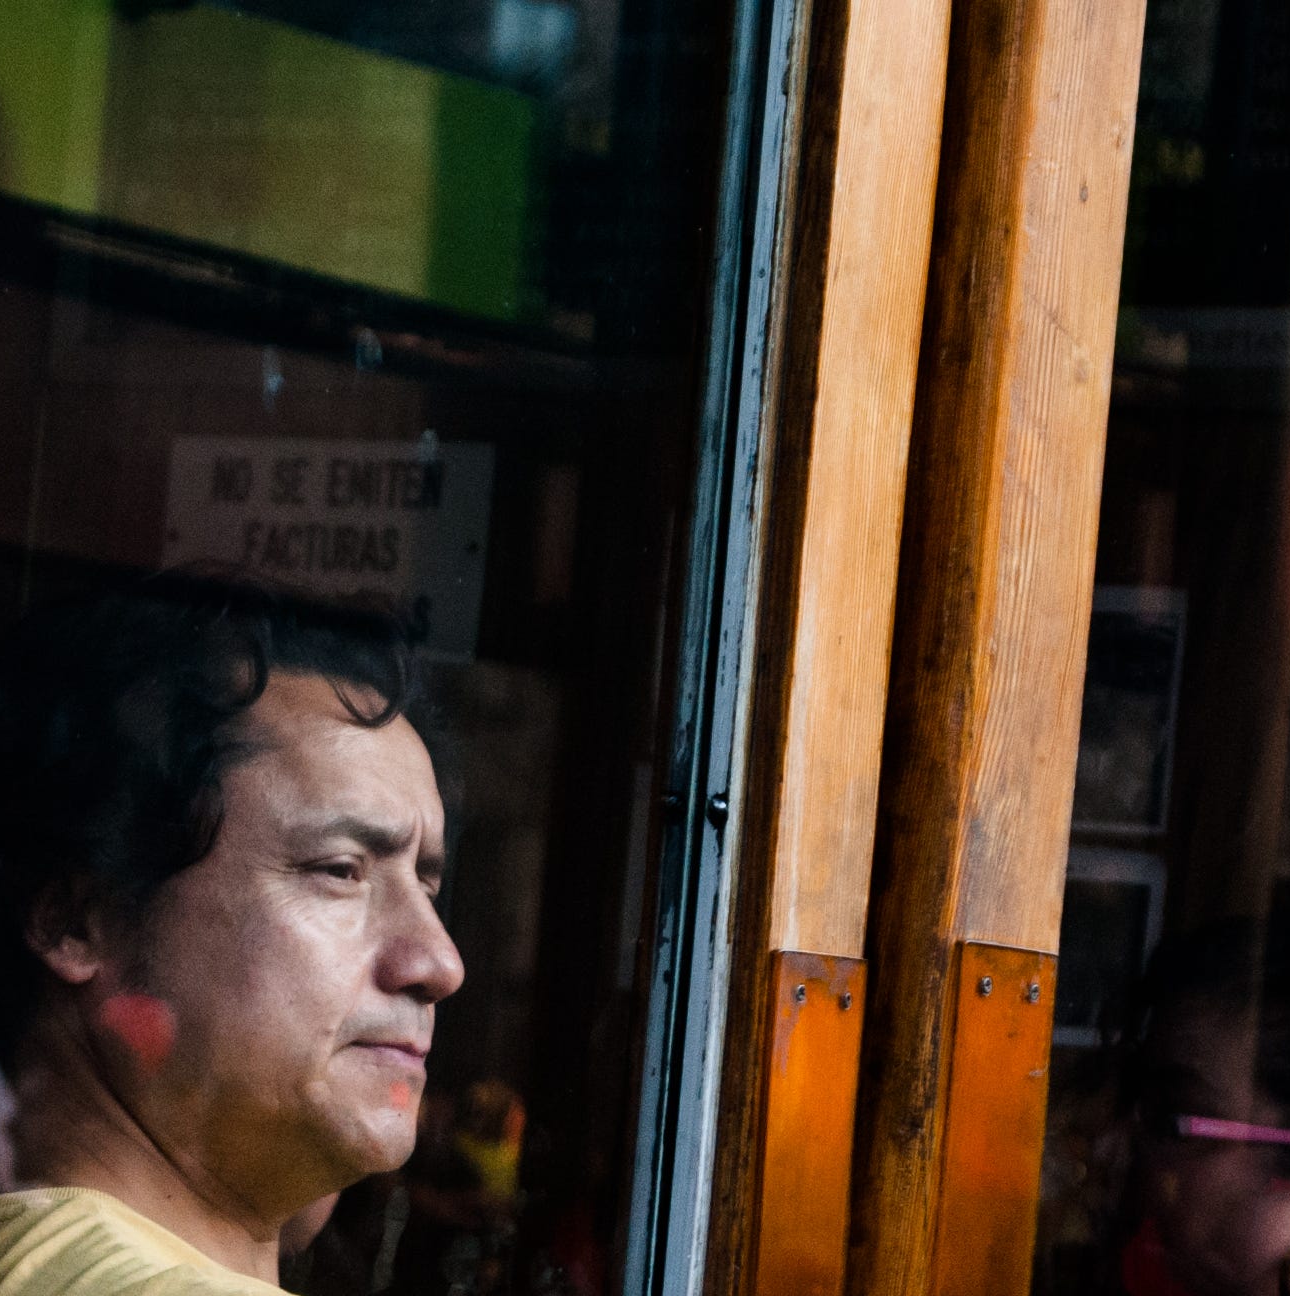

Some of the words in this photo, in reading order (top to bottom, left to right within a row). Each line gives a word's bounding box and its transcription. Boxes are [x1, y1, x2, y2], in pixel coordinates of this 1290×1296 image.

[211, 456, 253, 503] NO
[271, 457, 308, 505] SE
[326, 457, 445, 510] EMITEN
[243, 518, 399, 573] FACTURAS
